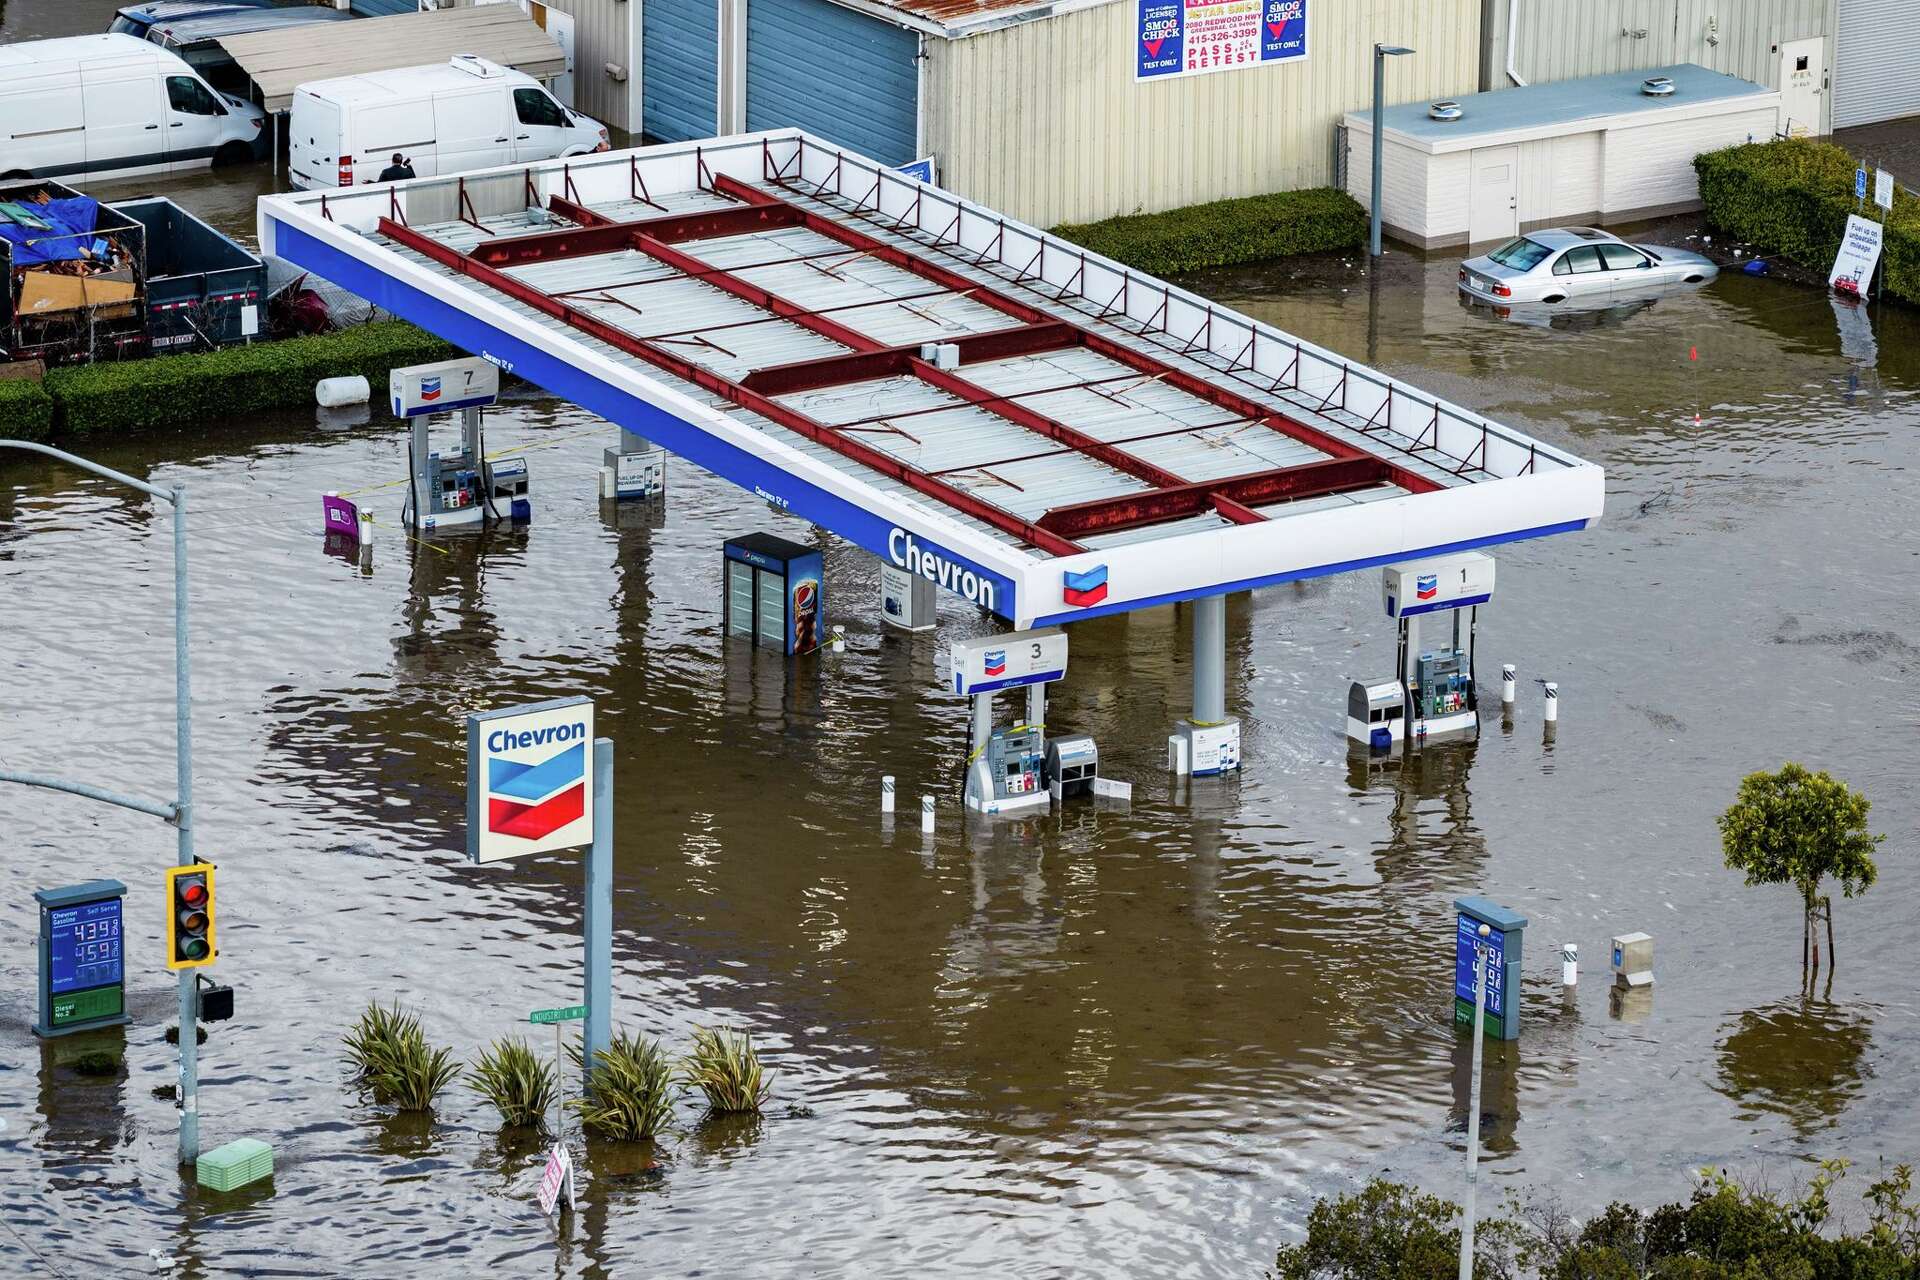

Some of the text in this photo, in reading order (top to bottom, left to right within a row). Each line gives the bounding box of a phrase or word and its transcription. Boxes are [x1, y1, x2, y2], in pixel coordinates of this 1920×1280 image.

[1270, 1, 1300, 13] SMOG
[1146, 9, 1177, 19] LICENSED
[1205, 15, 1243, 26] REDWOOD
[1244, 13, 1262, 21] HWY
[1266, 9, 1302, 22] CHECK
[1146, 19, 1177, 31] SMOG
[1142, 28, 1180, 40] CHECK
[1188, 28, 1257, 44] 415-326-3399
[1188, 43, 1232, 58] PASS
[1267, 40, 1300, 51] TEST ONLY
[1144, 58, 1177, 69] TEST ONLY
[1188, 51, 1257, 70] RETEST
[1851, 223, 1864, 232] Fuel
[464, 370, 474, 385] 7
[755, 485, 776, 503] Clearance
[889, 527, 994, 611] Chevron
[1461, 568, 1466, 583] 1
[984, 650, 1005, 658] Chevron
[1031, 643, 1041, 659] 3
[487, 722, 586, 753] Chevron
[53, 910, 78, 920] Chevron
[87, 907, 99, 915] Self
[53, 916, 76, 925] Gasoline
[55, 1004, 75, 1013] Diesel
[532, 1009, 569, 1023] INDUSTRIL
